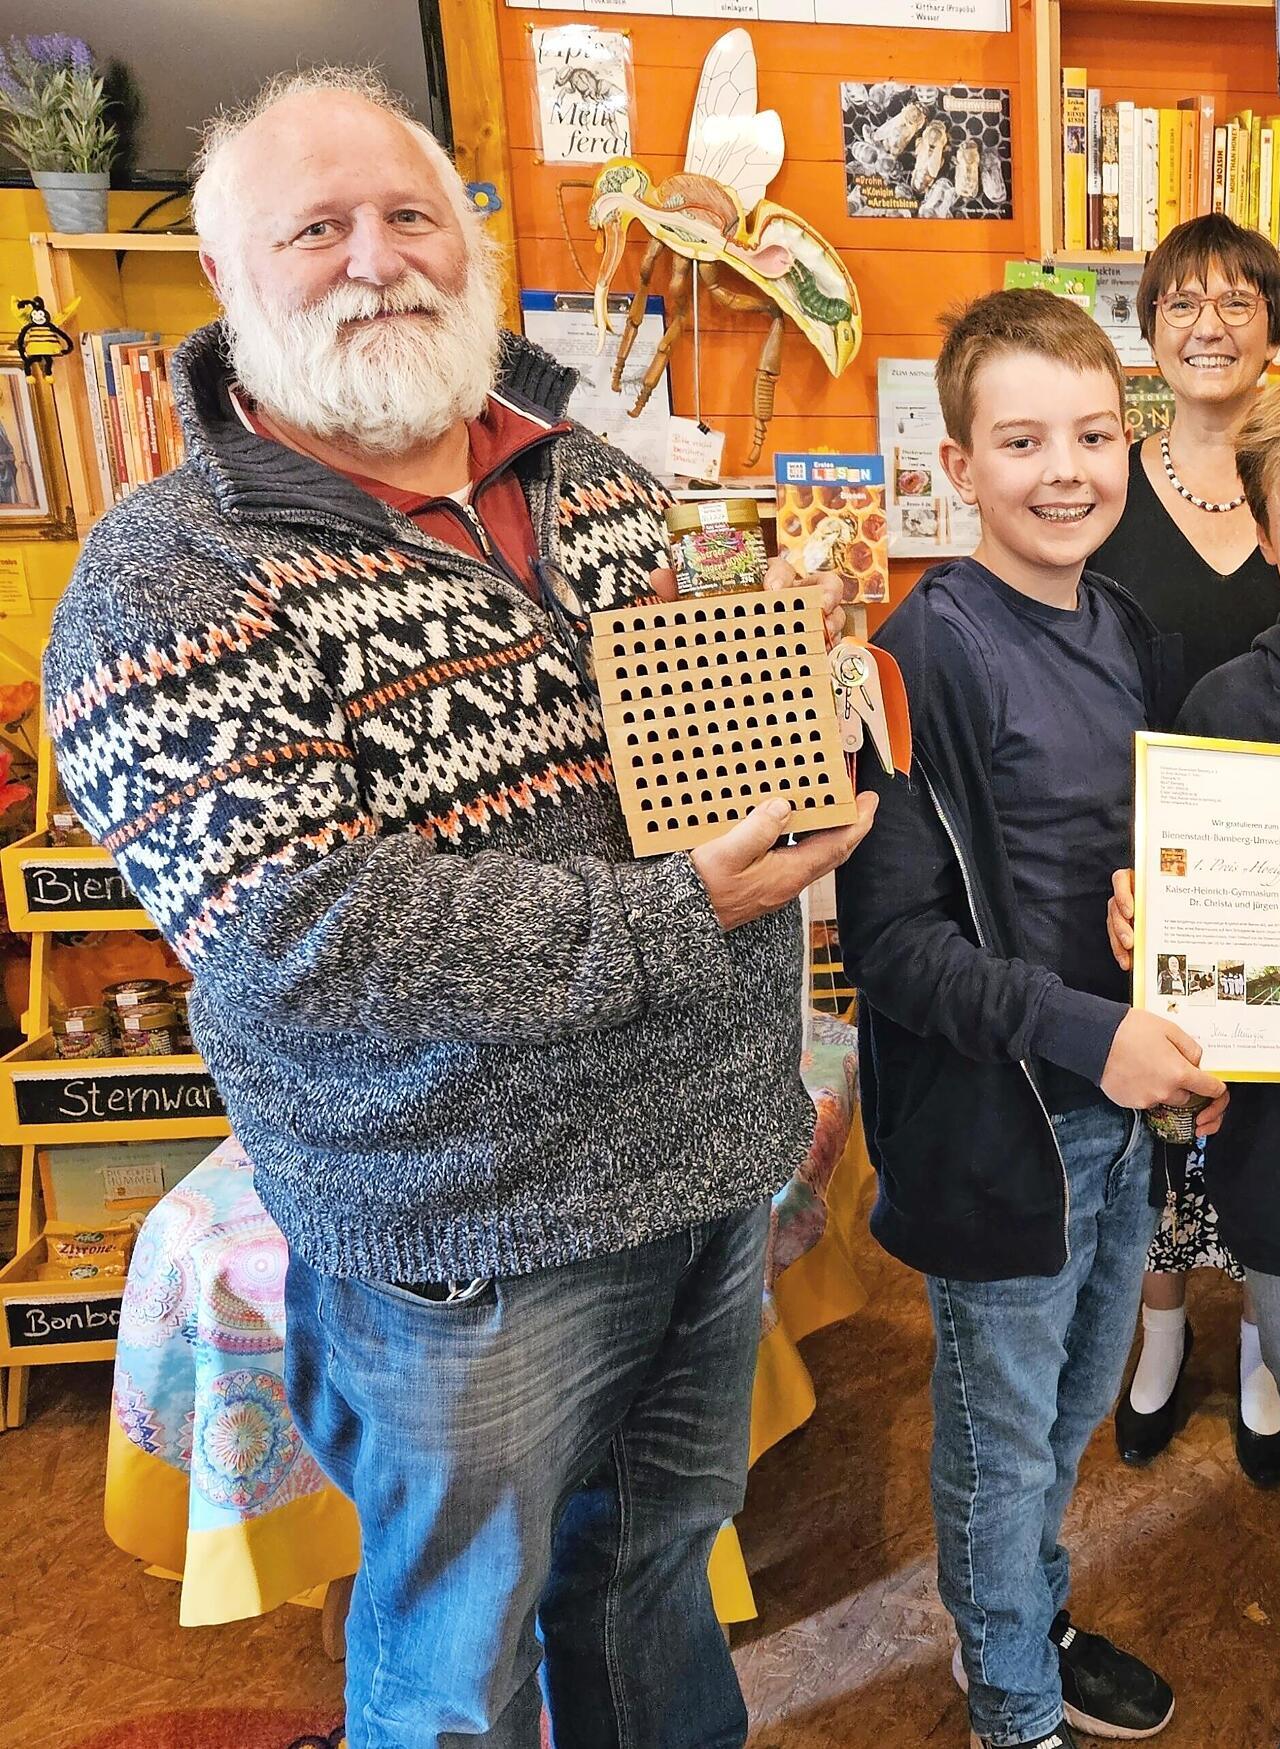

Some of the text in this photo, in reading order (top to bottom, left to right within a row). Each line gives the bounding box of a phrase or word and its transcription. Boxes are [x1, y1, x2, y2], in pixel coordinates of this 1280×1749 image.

[1211, 819, 1224, 827] Wir
[1226, 821, 1262, 830] gratulieren
[1165, 885, 1279, 899] Kaiser-Heinrich-Gymnasium
[1189, 898, 1201, 907] Dr.
[1203, 898, 1233, 908] Christa
[1234, 900, 1250, 908] und
[1252, 900, 1279, 911] Jürgen
